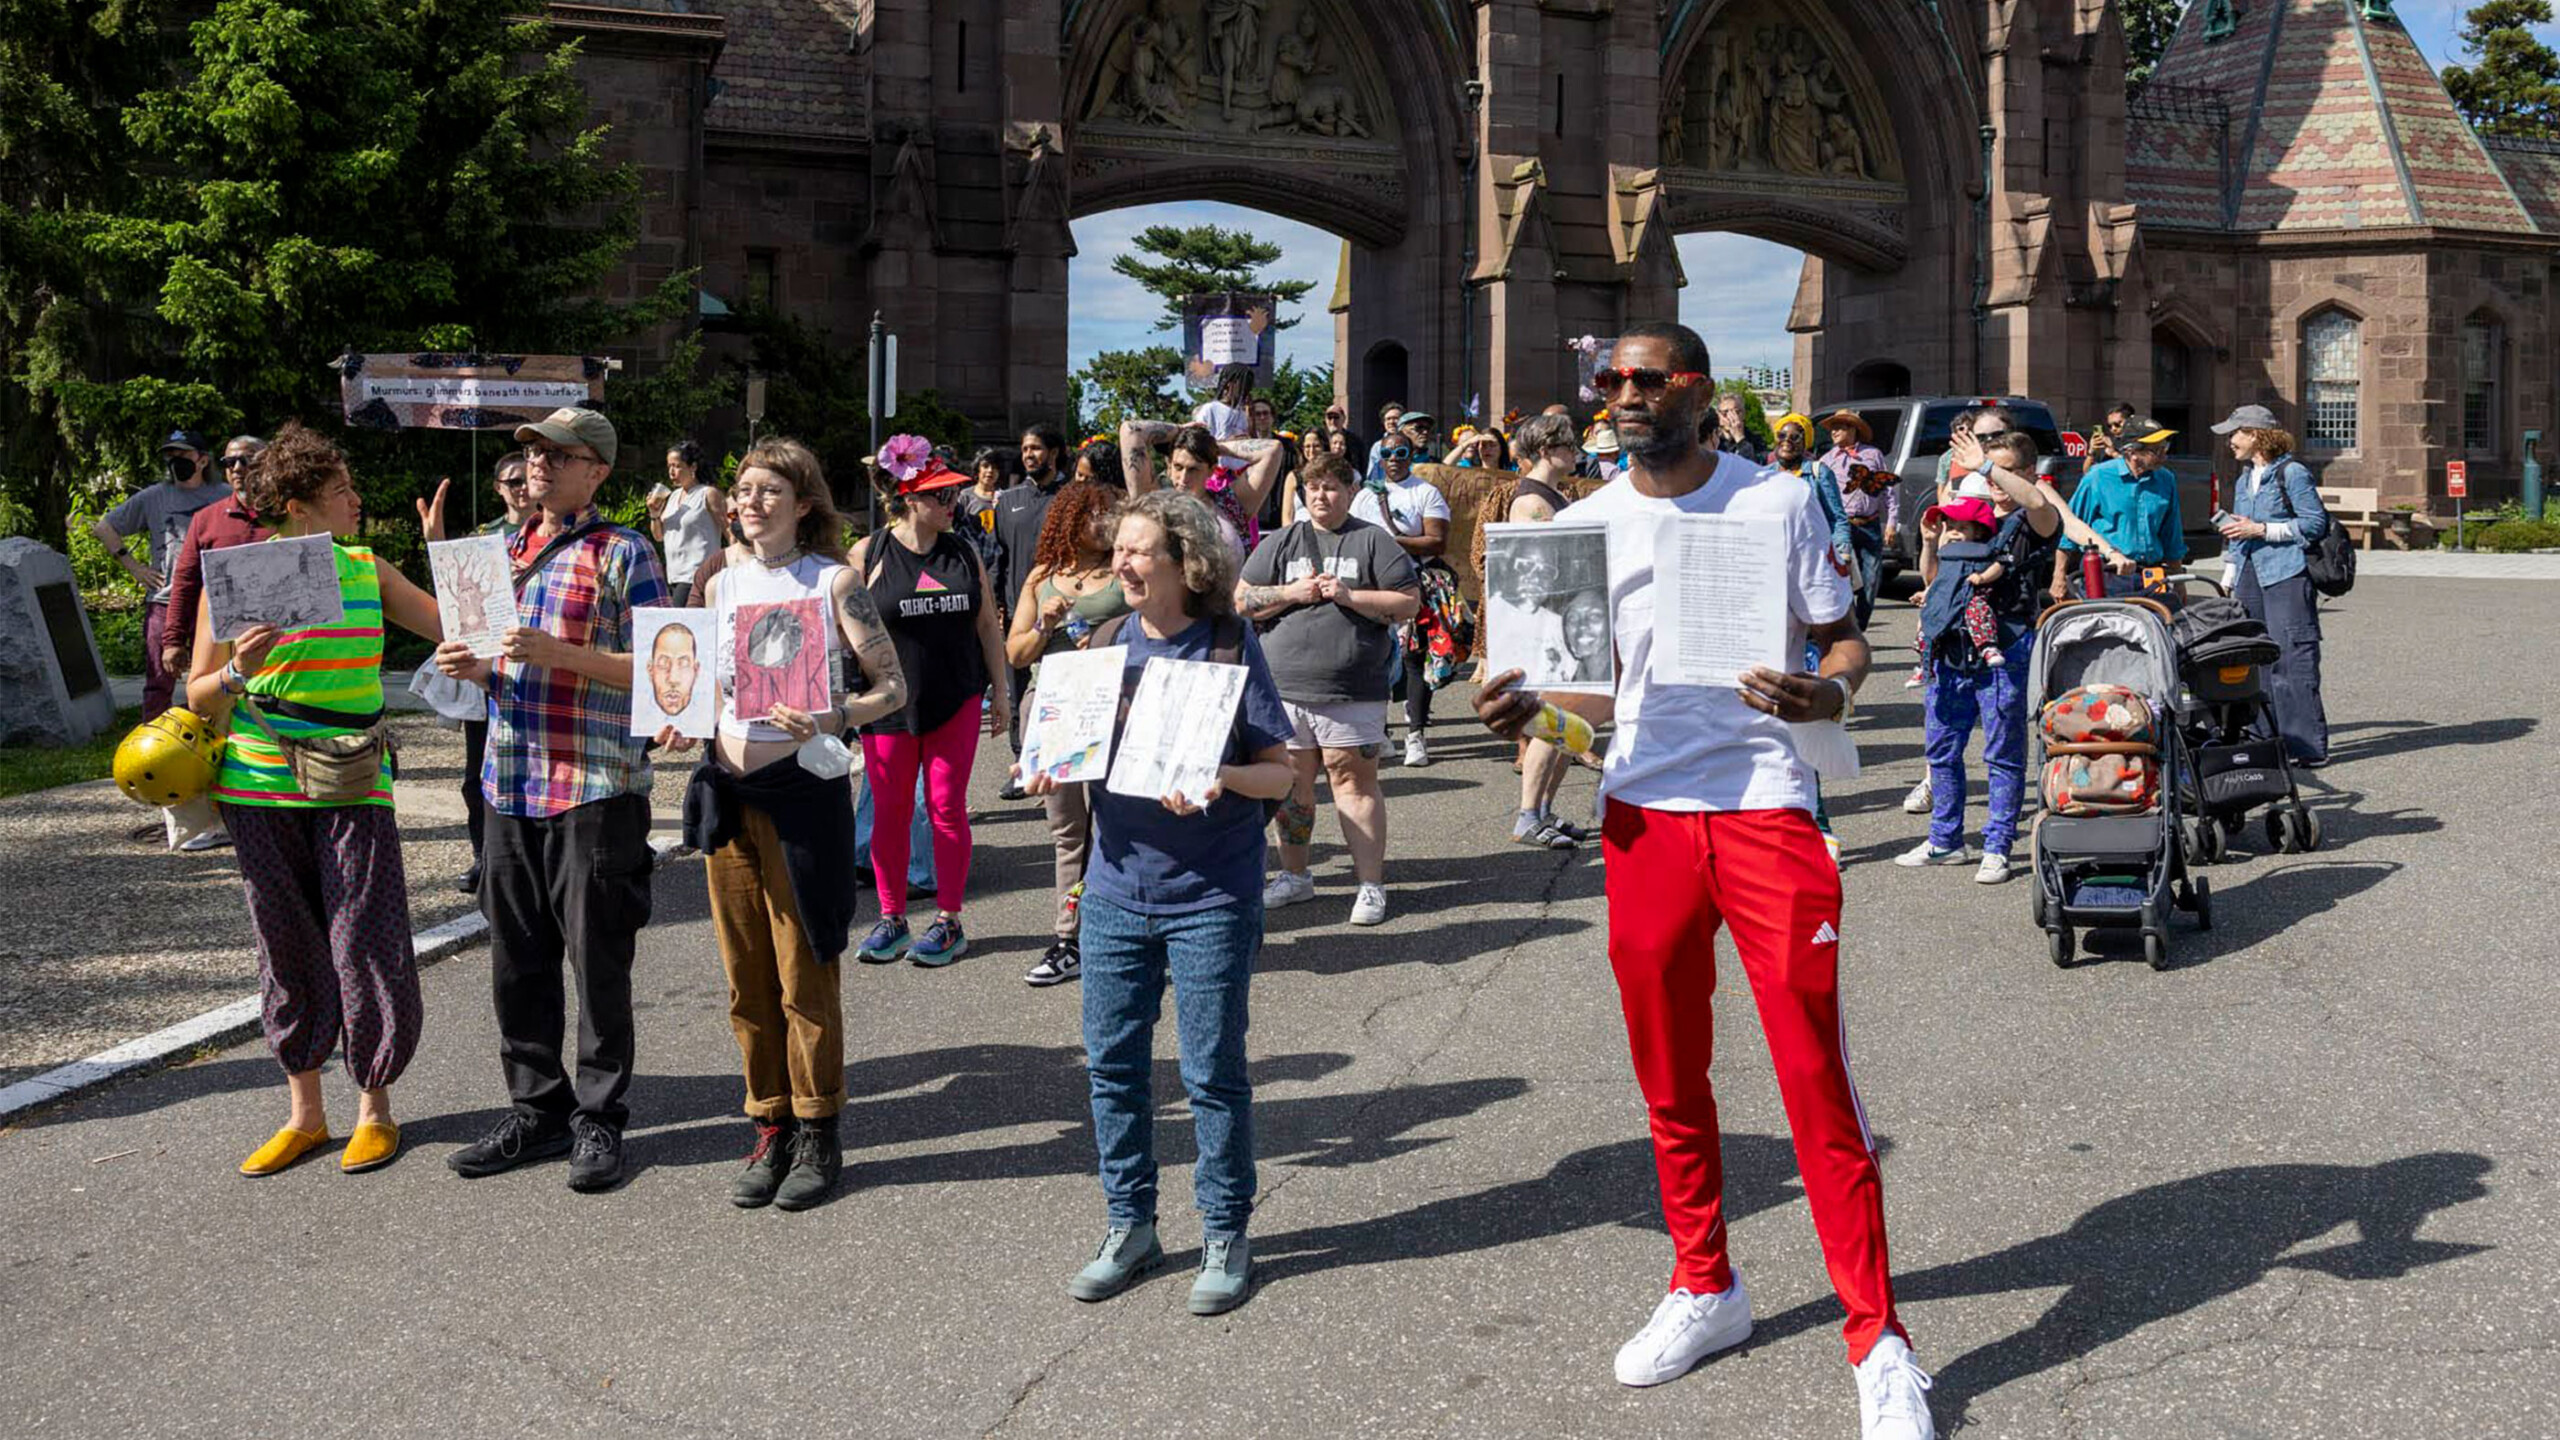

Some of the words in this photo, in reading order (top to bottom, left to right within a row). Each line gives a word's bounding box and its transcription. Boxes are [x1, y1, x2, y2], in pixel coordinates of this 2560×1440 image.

[475, 386, 520, 397] beneath
[523, 387, 541, 397] the
[545, 387, 583, 397] surface
[2064, 442, 2084, 457] OP
[899, 597, 934, 618] SILENCE
[940, 594, 970, 613] DEATH
[737, 652, 830, 720] PINK
